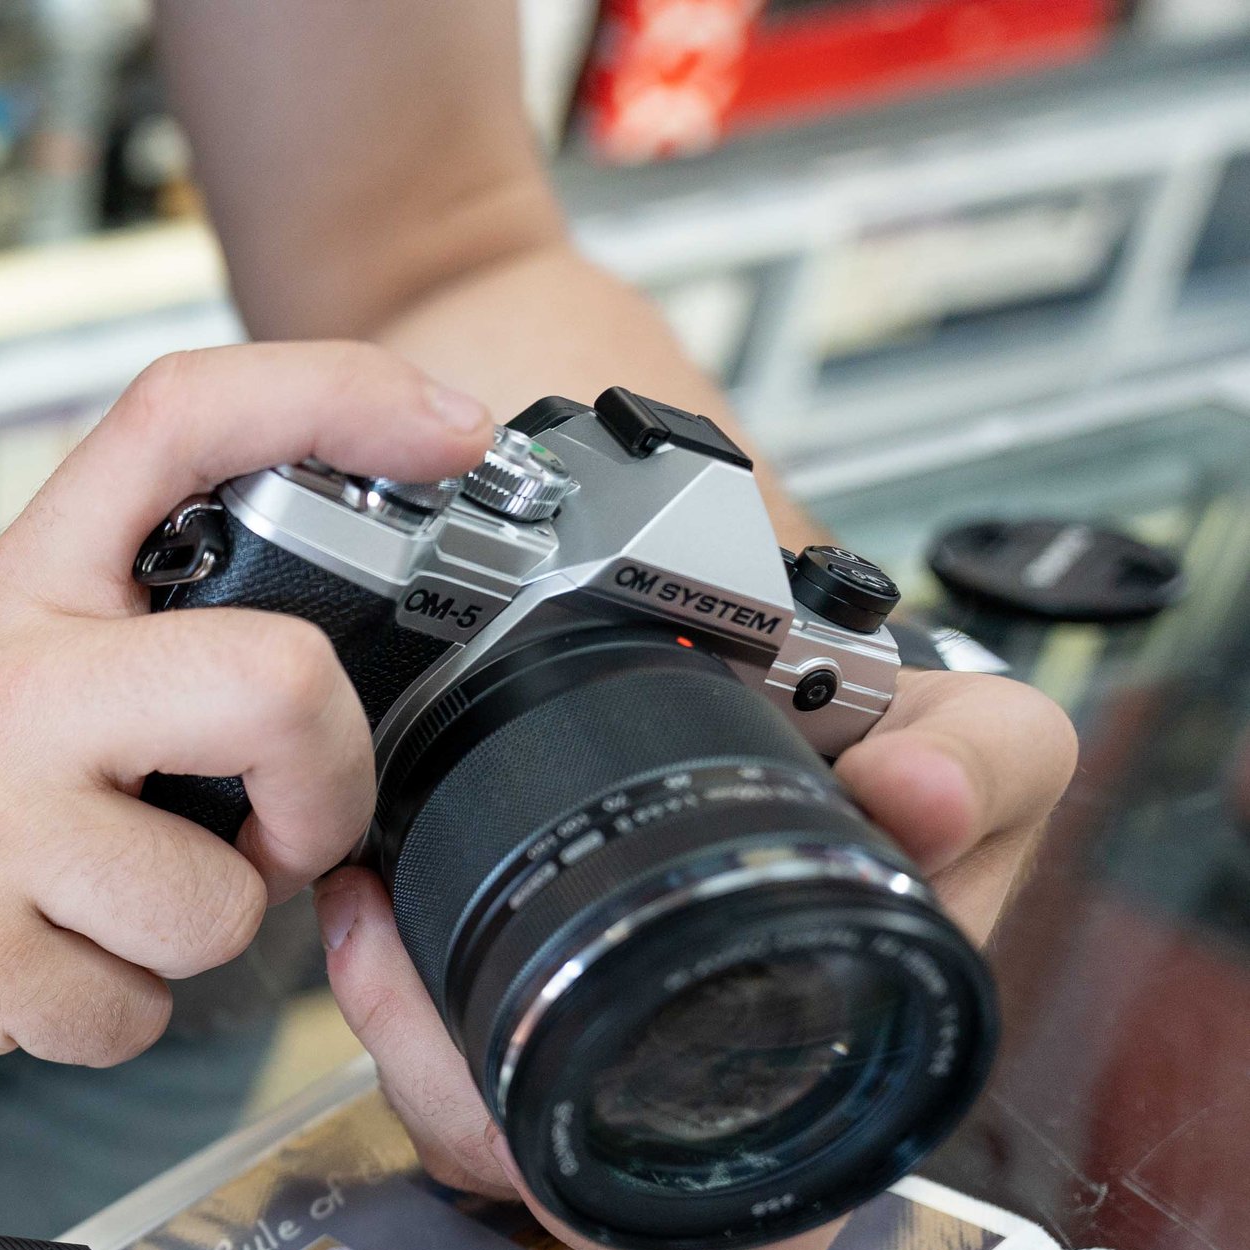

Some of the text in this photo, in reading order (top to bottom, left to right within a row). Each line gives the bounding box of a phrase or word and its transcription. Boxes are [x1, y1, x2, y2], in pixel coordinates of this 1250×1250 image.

[404, 589, 483, 630] OM-5
[614, 566, 782, 634] OM SYSTEM
